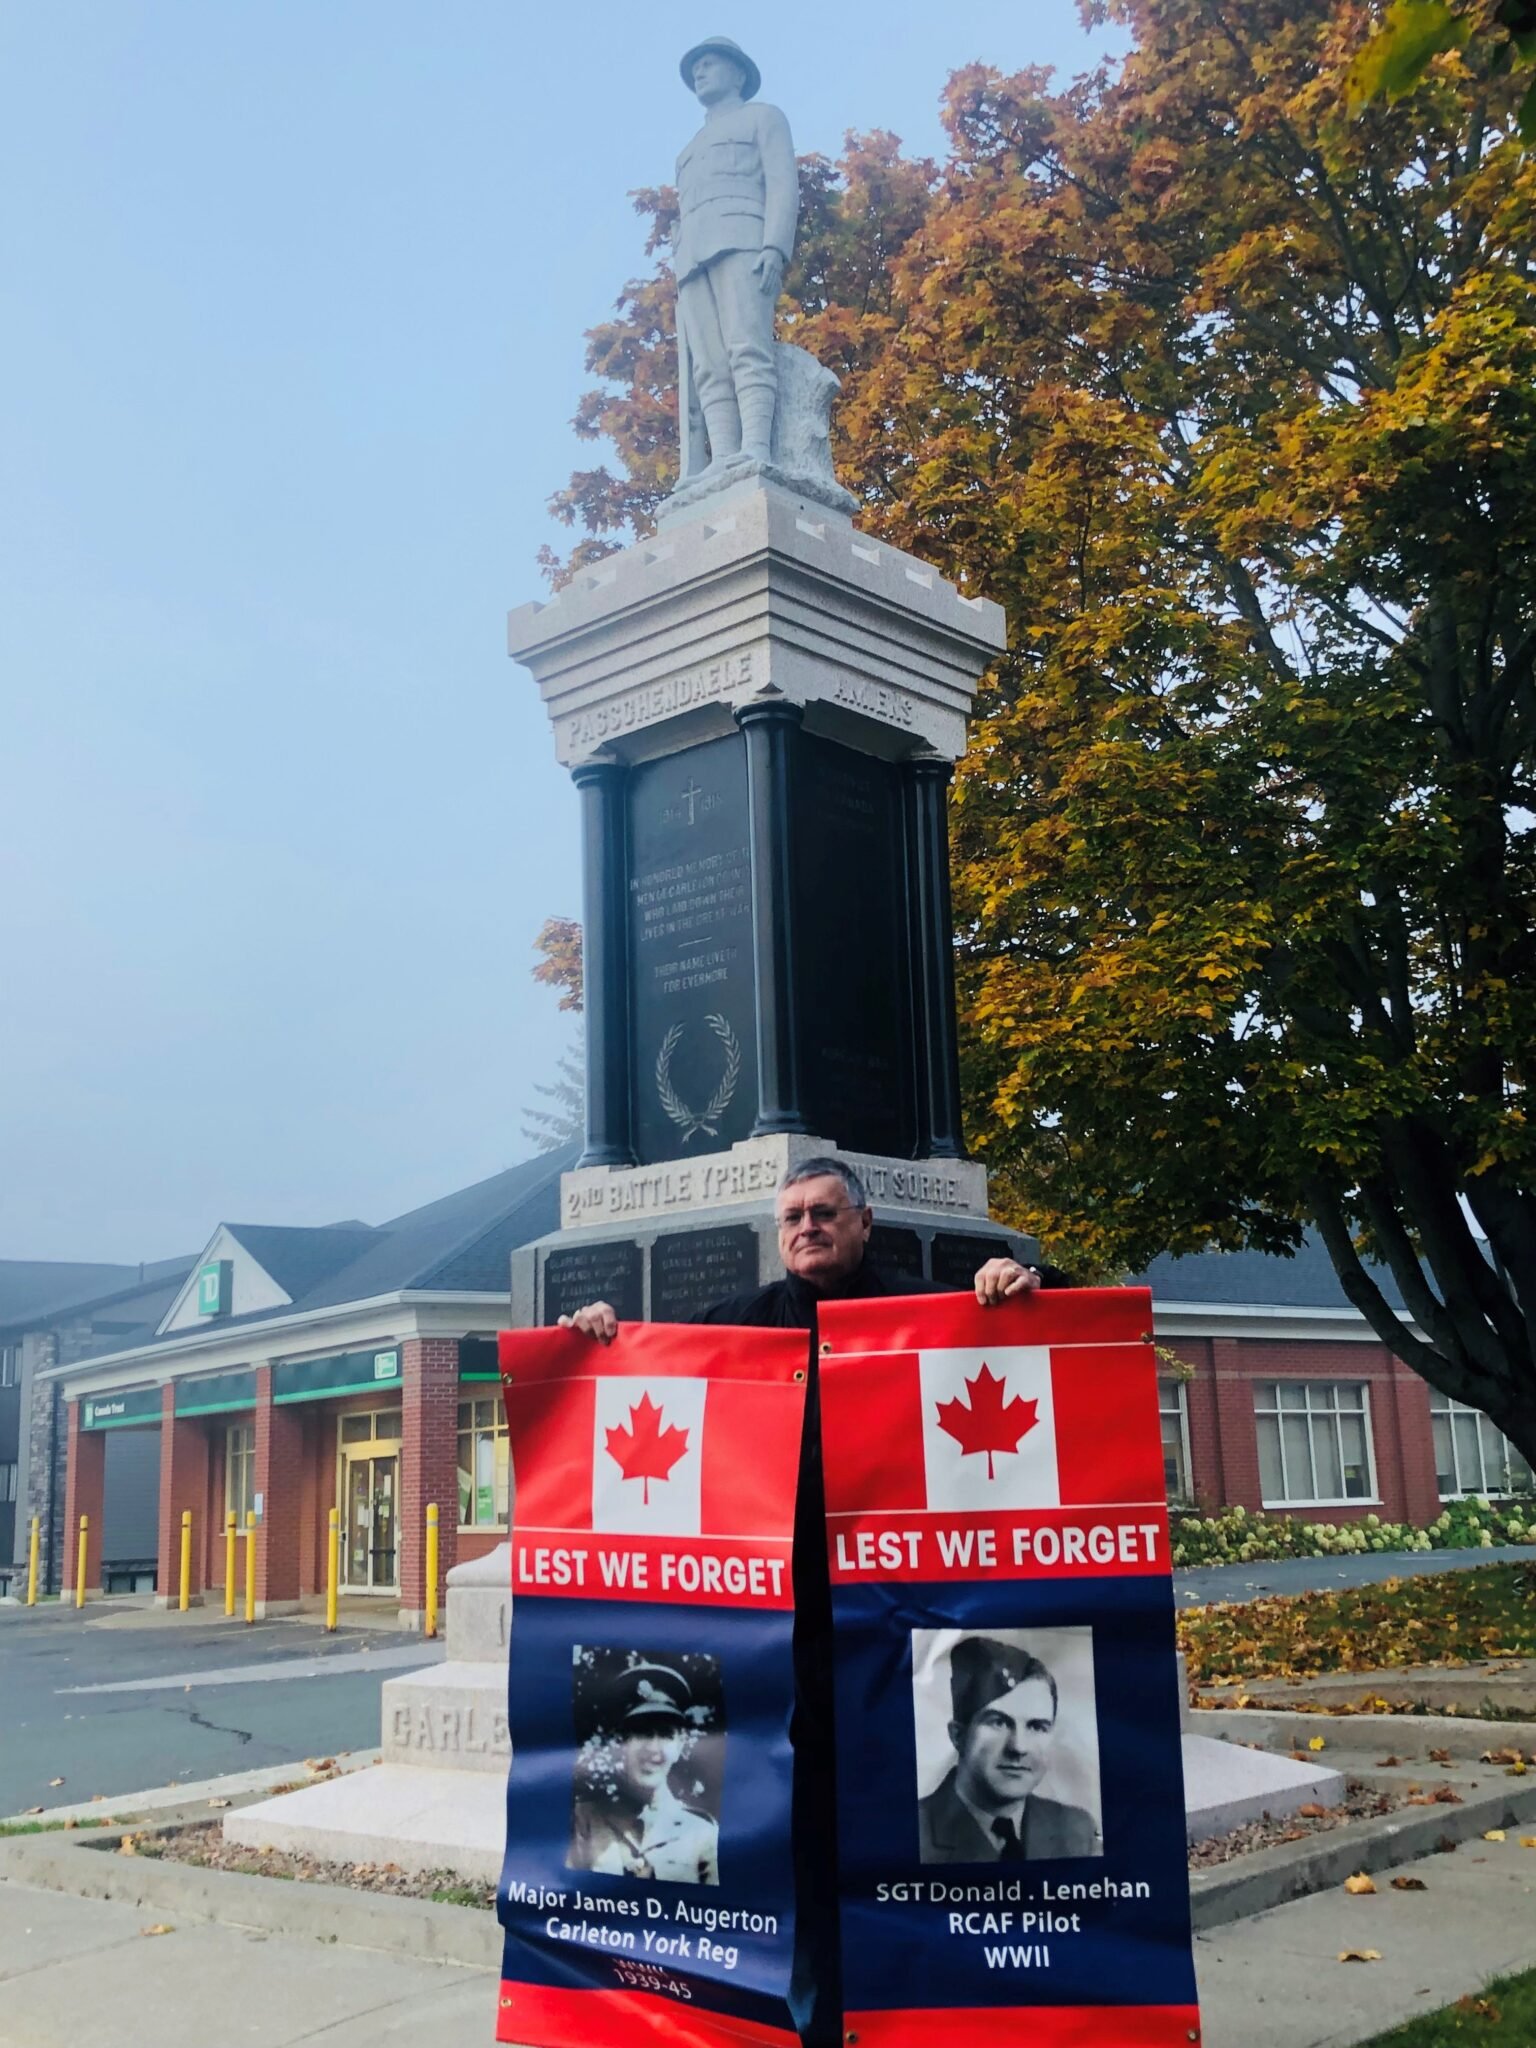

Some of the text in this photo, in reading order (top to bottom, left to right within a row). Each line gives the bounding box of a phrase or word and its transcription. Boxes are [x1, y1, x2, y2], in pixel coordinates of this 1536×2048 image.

[568, 656, 753, 749] PASSCHENDAELE
[609, 1171, 692, 1214] BATTLE
[701, 1157, 779, 1199] YPRES
[892, 1167, 970, 1209] SORREL
[203, 1273, 219, 1303] TD
[836, 1524, 1159, 1571] LEST WE FORGET
[519, 1547, 785, 1596] LEST WE FORGET
[508, 1881, 778, 1935] Major James D. Augerton
[876, 1883, 925, 1902] SGT
[930, 1880, 1021, 1902] Donald
[1043, 1877, 1150, 1900] Lenehan
[546, 1917, 739, 1970] Carleton York Reg
[949, 1911, 1081, 1934] RCAF Pilot
[984, 1945, 1050, 1968] WWII
[613, 1968, 692, 1999] 1939-45
